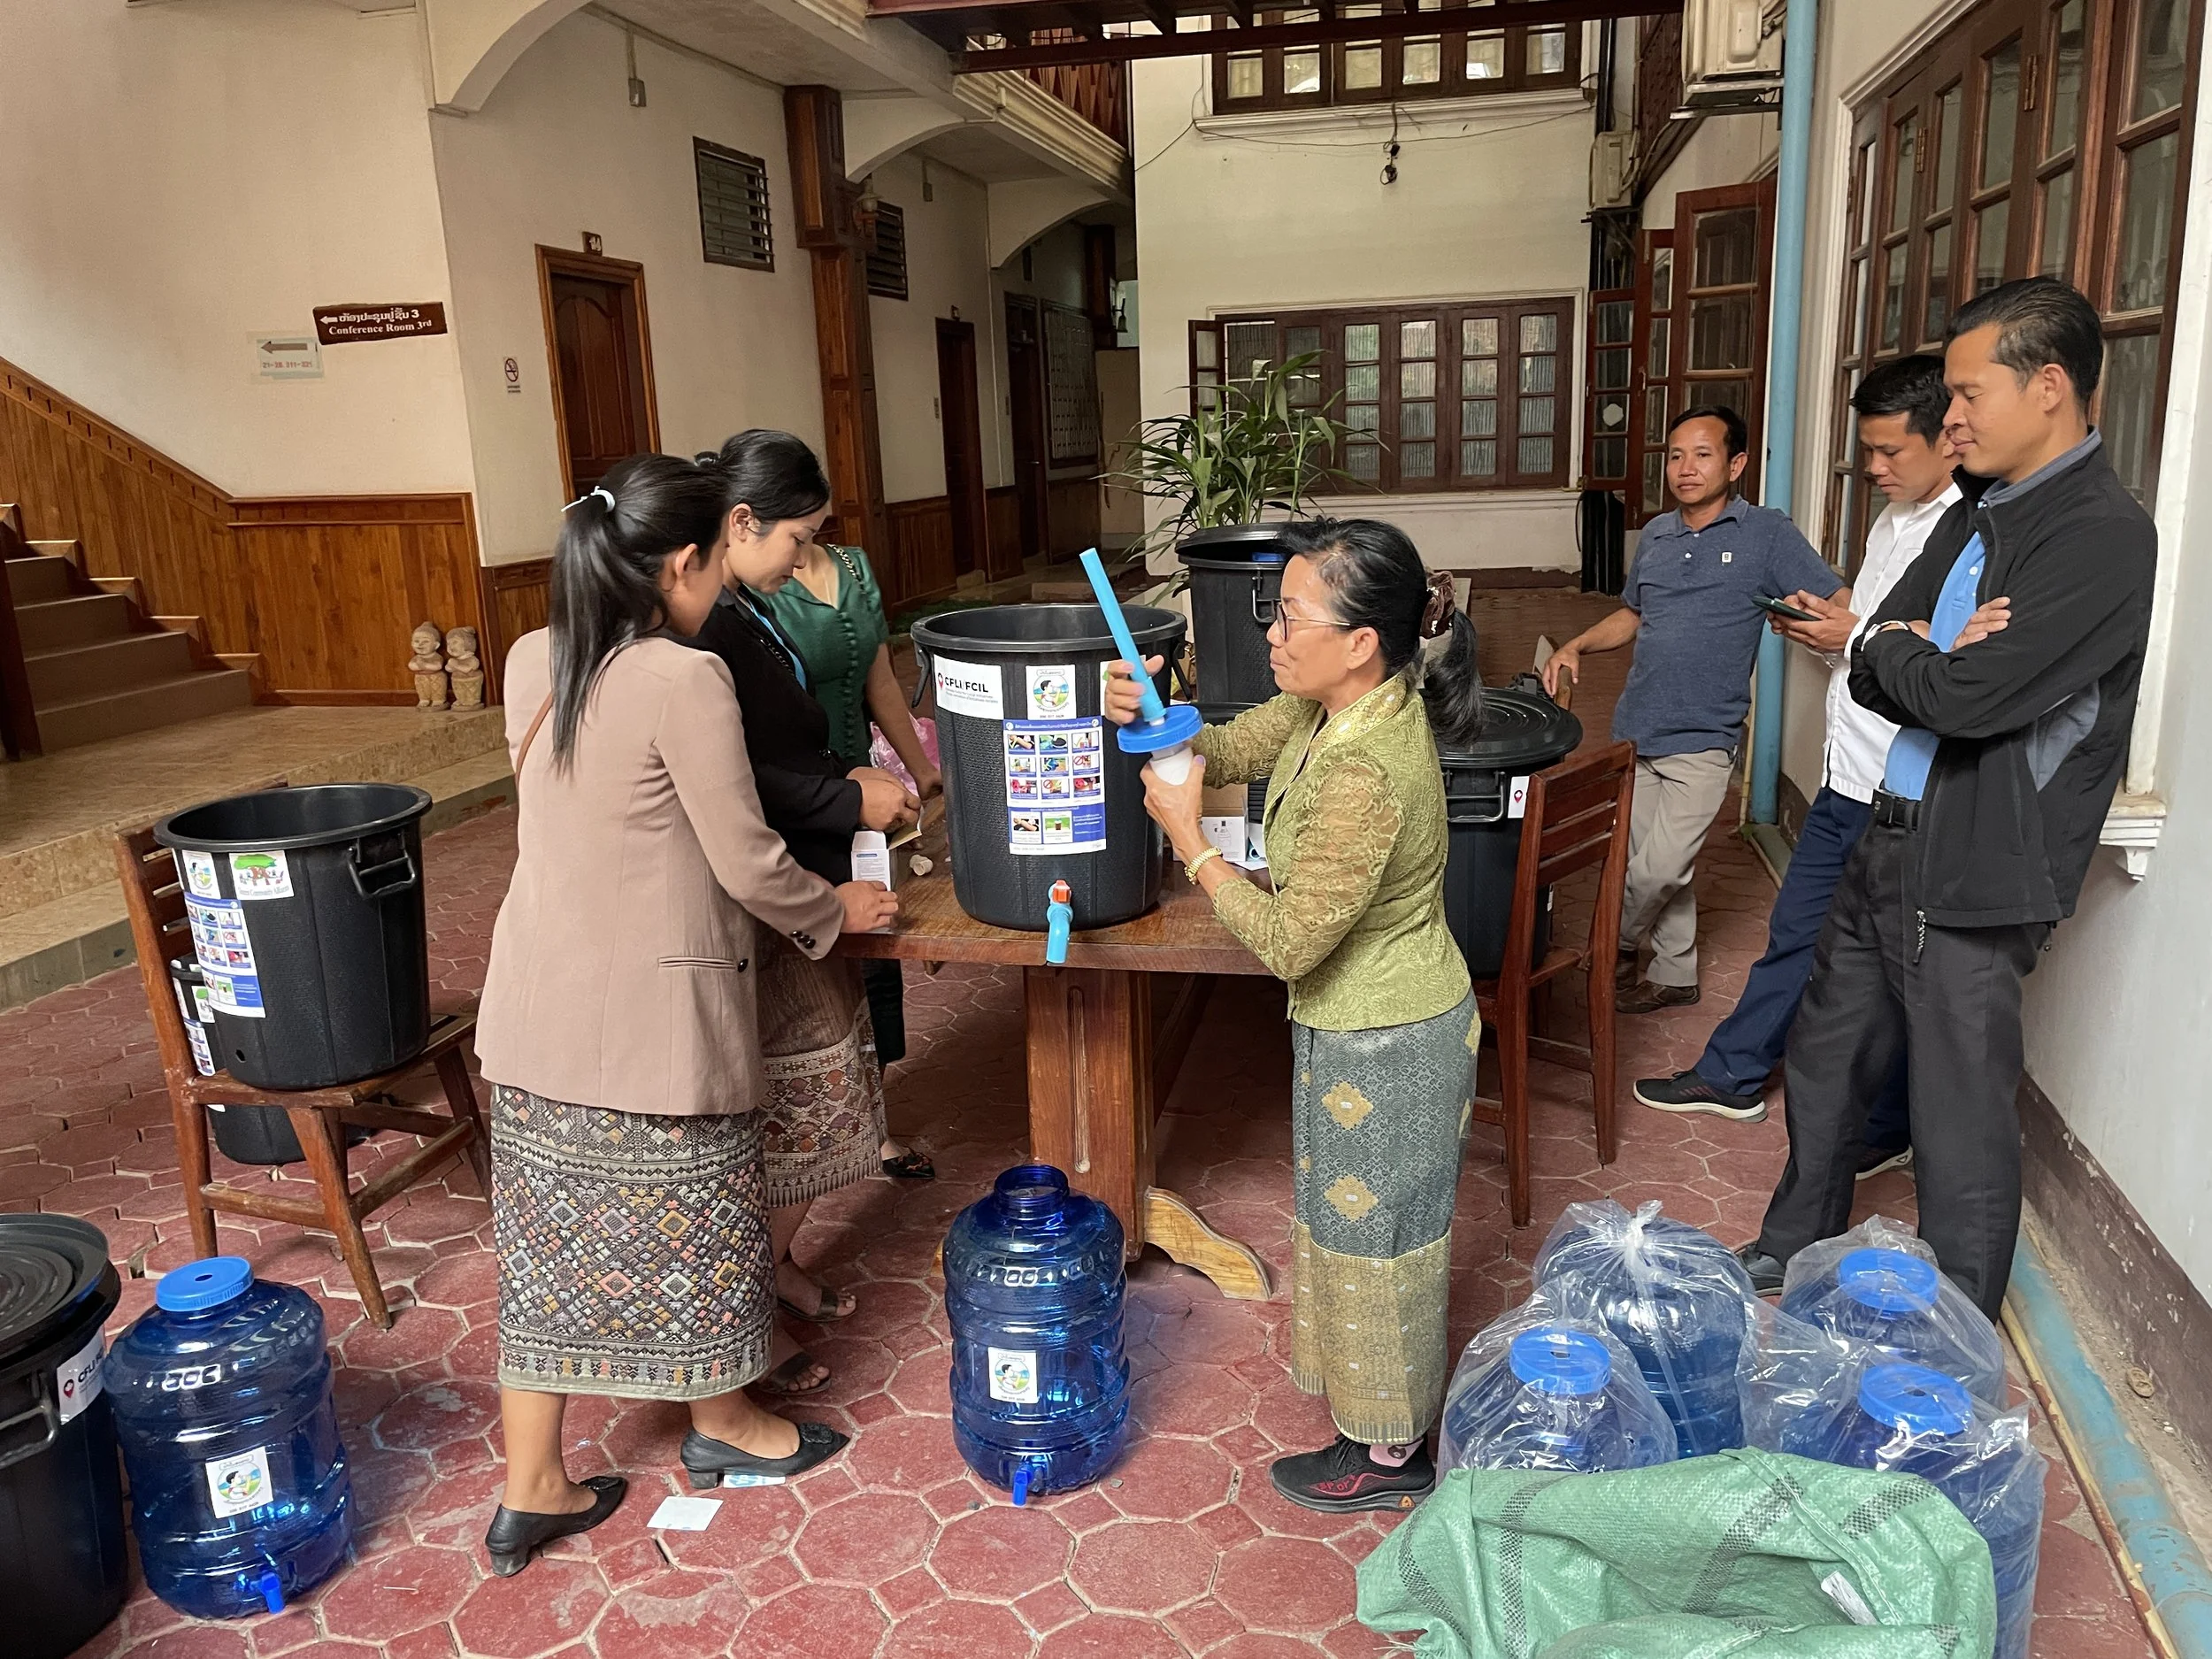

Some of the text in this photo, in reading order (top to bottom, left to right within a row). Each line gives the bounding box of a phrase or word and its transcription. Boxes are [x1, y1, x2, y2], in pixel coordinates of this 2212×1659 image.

[411, 309, 420, 319] 3
[328, 319, 433, 335] Conference Room 3rd
